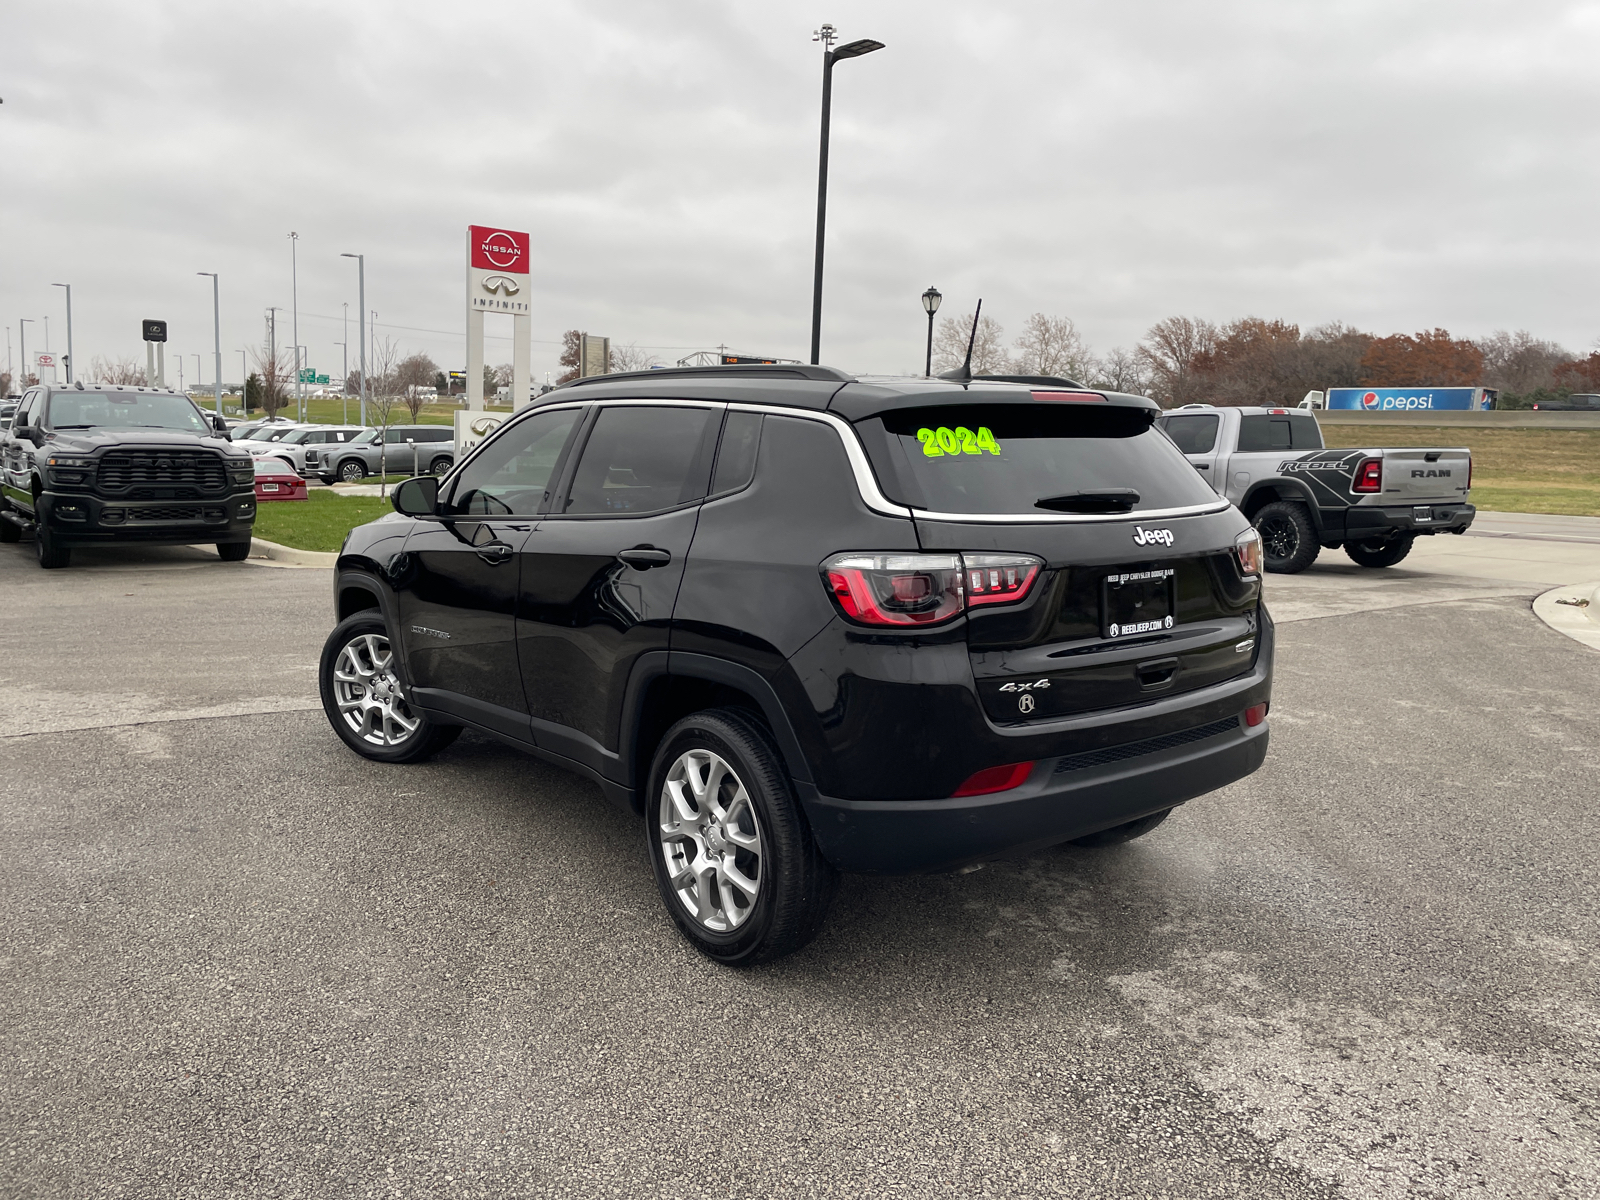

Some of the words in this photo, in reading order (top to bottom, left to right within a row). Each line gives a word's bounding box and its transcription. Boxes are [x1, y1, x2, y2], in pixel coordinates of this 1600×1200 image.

[481, 243, 521, 255] NISSAN
[473, 297, 528, 311] INFINITI
[1383, 394, 1433, 411] pepsi
[917, 426, 1001, 458] 2024
[1276, 460, 1349, 472] REBEL
[1411, 469, 1451, 478] RAM
[1132, 525, 1174, 548] Jeep
[1107, 574, 1119, 583] REED
[1120, 573, 1130, 581] JEEP
[1130, 571, 1151, 580] CHRYSLER
[1151, 569, 1164, 578] DODGE
[1121, 620, 1162, 635] REEDJEEP.COM
[999, 678, 1051, 692] 4x4
